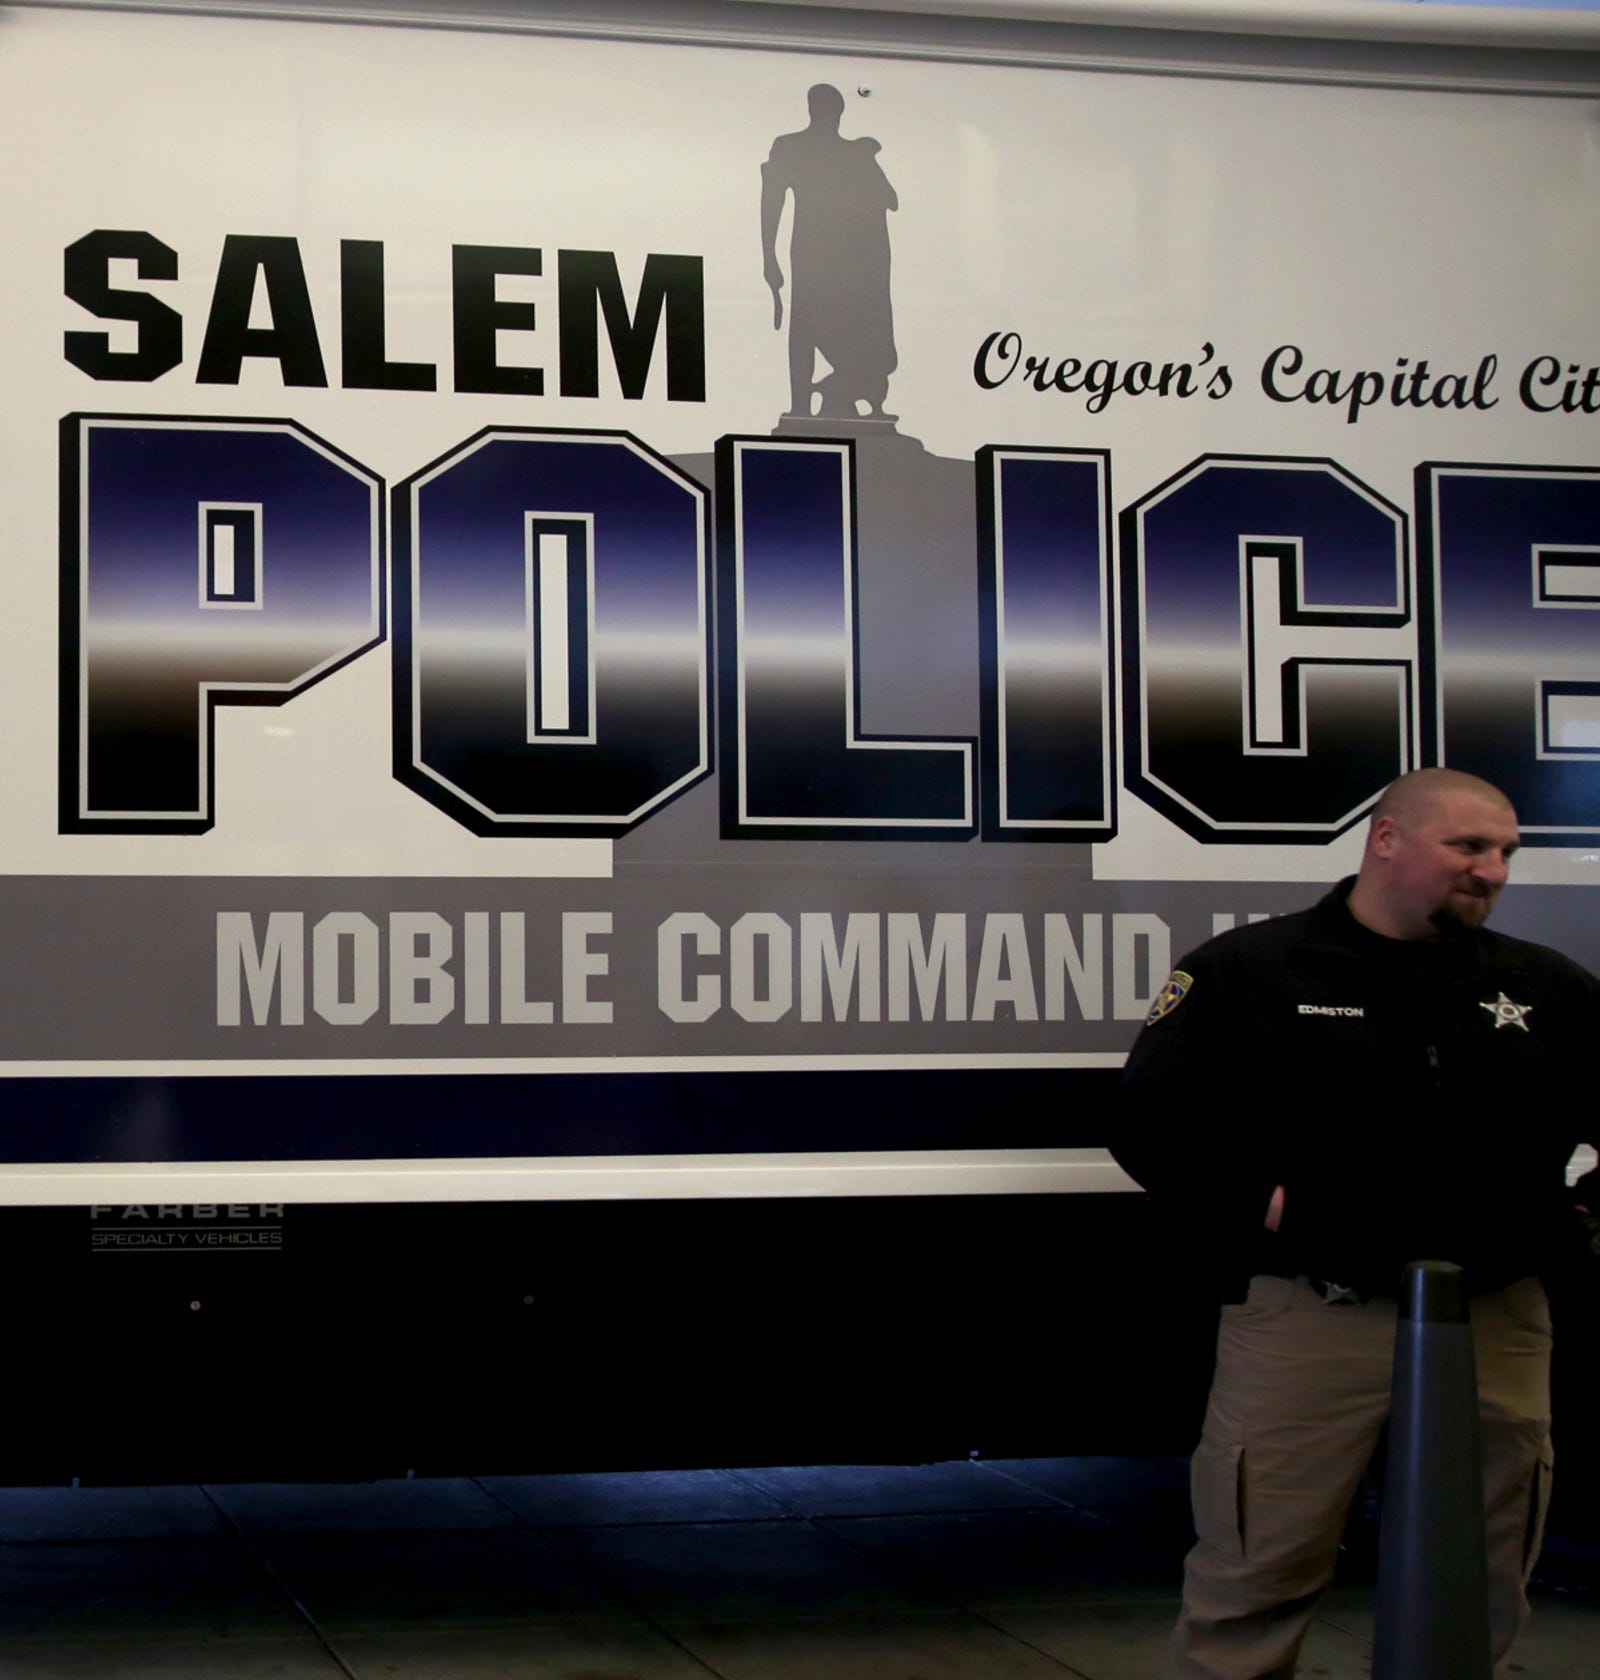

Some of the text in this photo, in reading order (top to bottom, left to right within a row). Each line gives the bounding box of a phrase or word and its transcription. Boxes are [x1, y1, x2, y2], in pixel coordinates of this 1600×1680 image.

[63, 229, 706, 403] SALEM
[973, 331, 1600, 424] Oregon's Capital Cit
[58, 411, 1600, 844] POLICE
[216, 912, 1171, 1026] MOBILE COMMAND
[1297, 1004, 1365, 1017] EDMISTON
[91, 1231, 283, 1246] SPECIALTY VEHICLES
